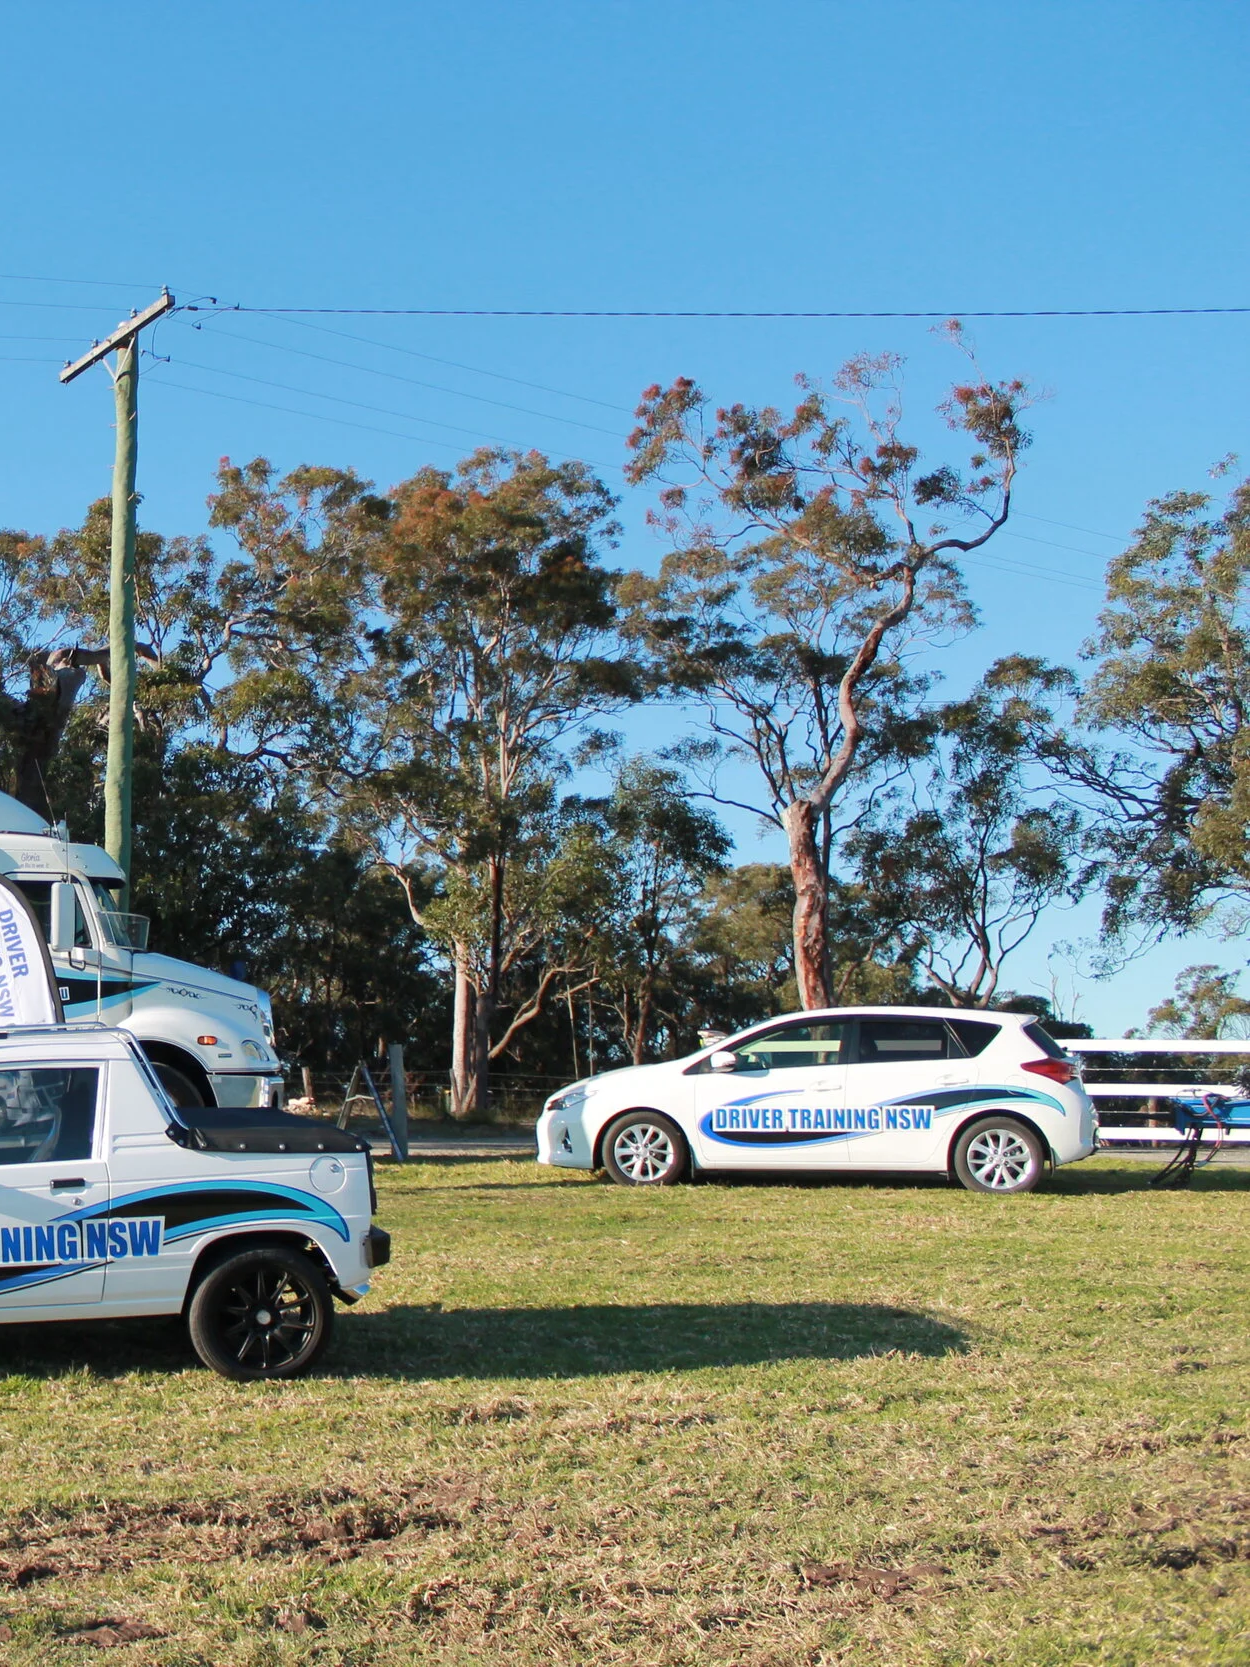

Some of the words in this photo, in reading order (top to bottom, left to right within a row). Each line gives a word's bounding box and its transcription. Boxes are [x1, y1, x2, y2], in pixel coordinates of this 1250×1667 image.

[21, 852, 40, 862] Gloria
[715, 1108, 783, 1130] DRIVER
[787, 1108, 880, 1130] TRAINING
[885, 1108, 932, 1130] NSW
[87, 1219, 162, 1259] NSW
